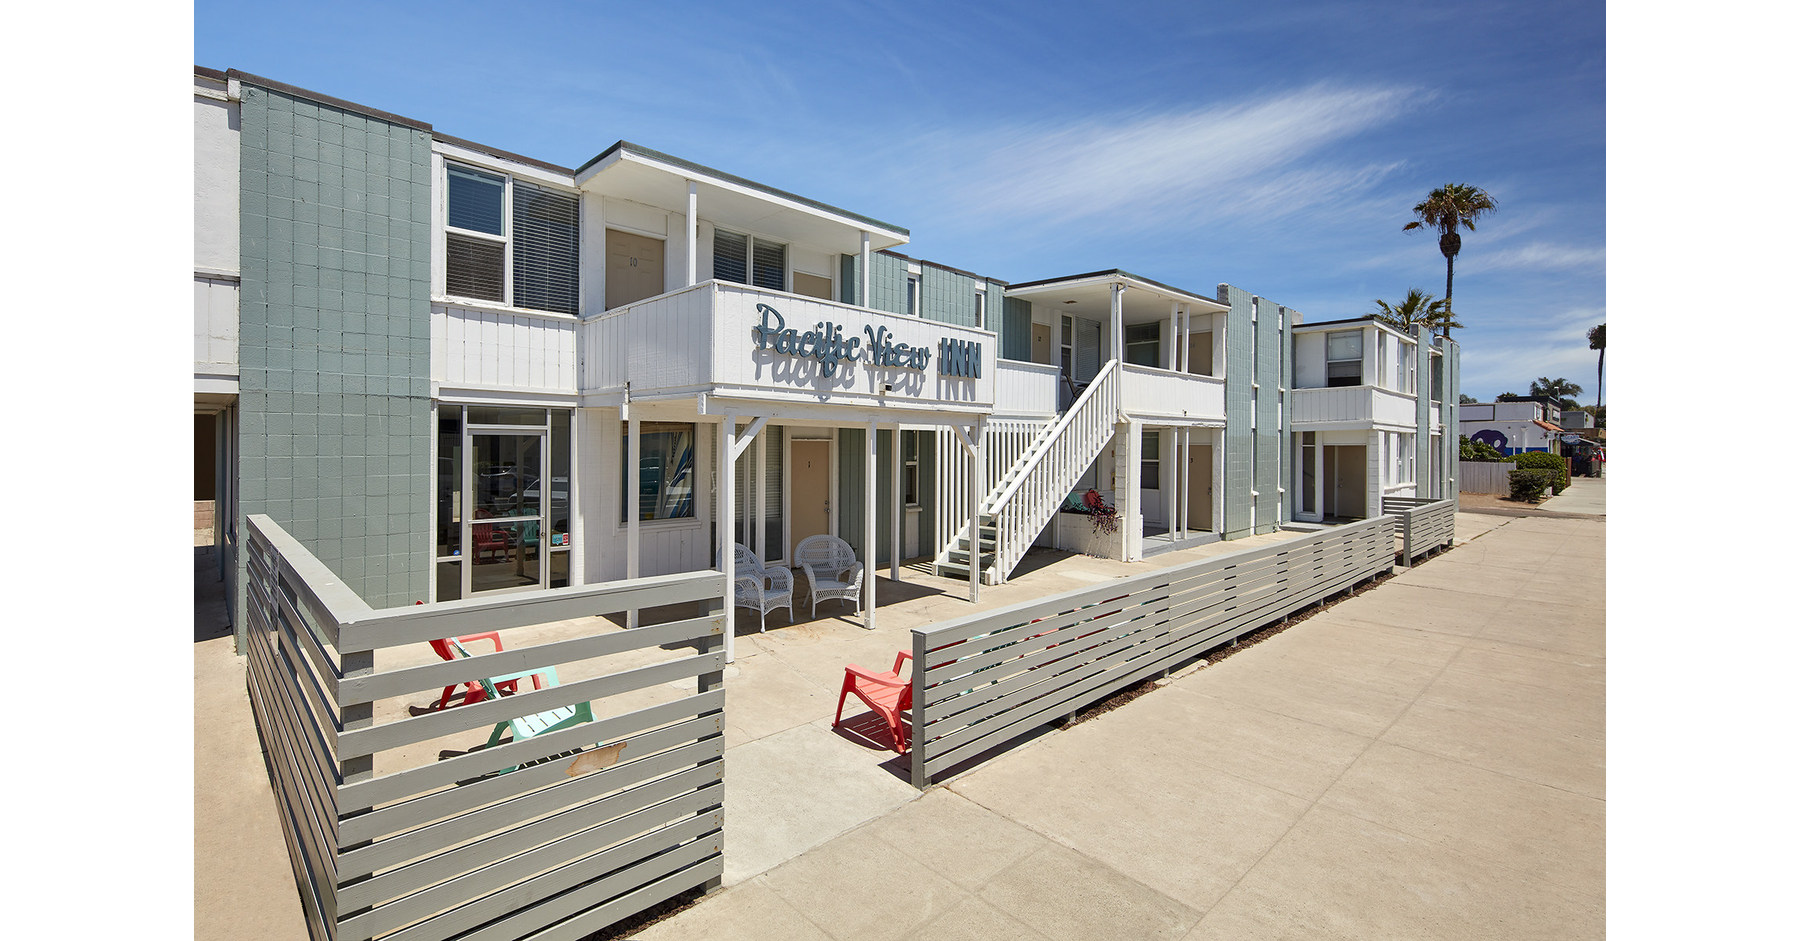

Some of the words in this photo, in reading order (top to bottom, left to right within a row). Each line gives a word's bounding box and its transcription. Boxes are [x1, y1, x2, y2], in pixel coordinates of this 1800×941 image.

[629, 256, 638, 267] 10
[755, 303, 861, 378] Pacific
[864, 324, 932, 371] View
[939, 337, 982, 379] INN
